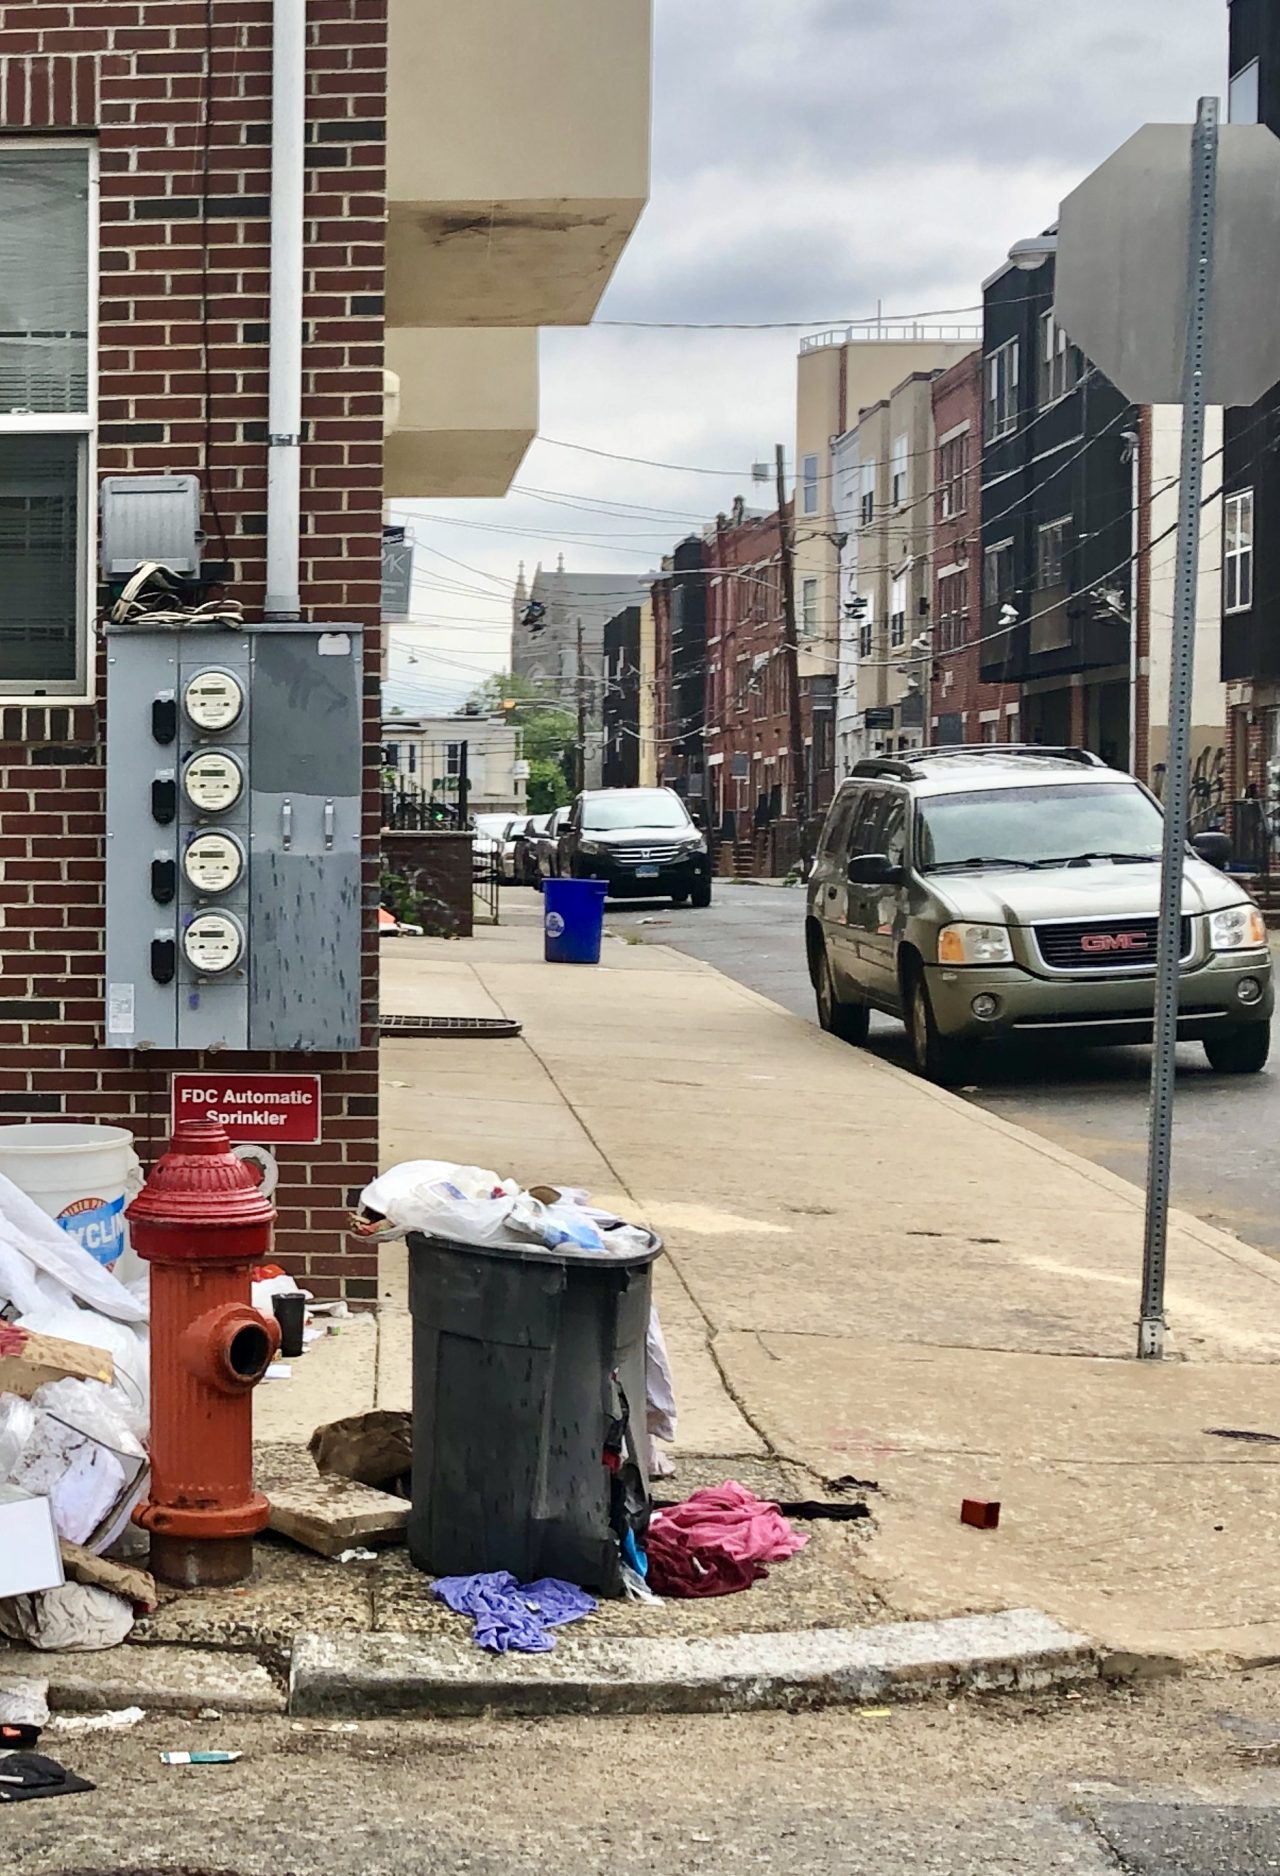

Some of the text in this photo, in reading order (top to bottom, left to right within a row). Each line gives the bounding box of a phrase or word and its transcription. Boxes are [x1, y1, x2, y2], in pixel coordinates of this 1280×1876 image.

[1081, 932, 1148, 951] GMC
[181, 1088, 313, 1104] FDC Automatic
[206, 1110, 287, 1125] Sprinkler
